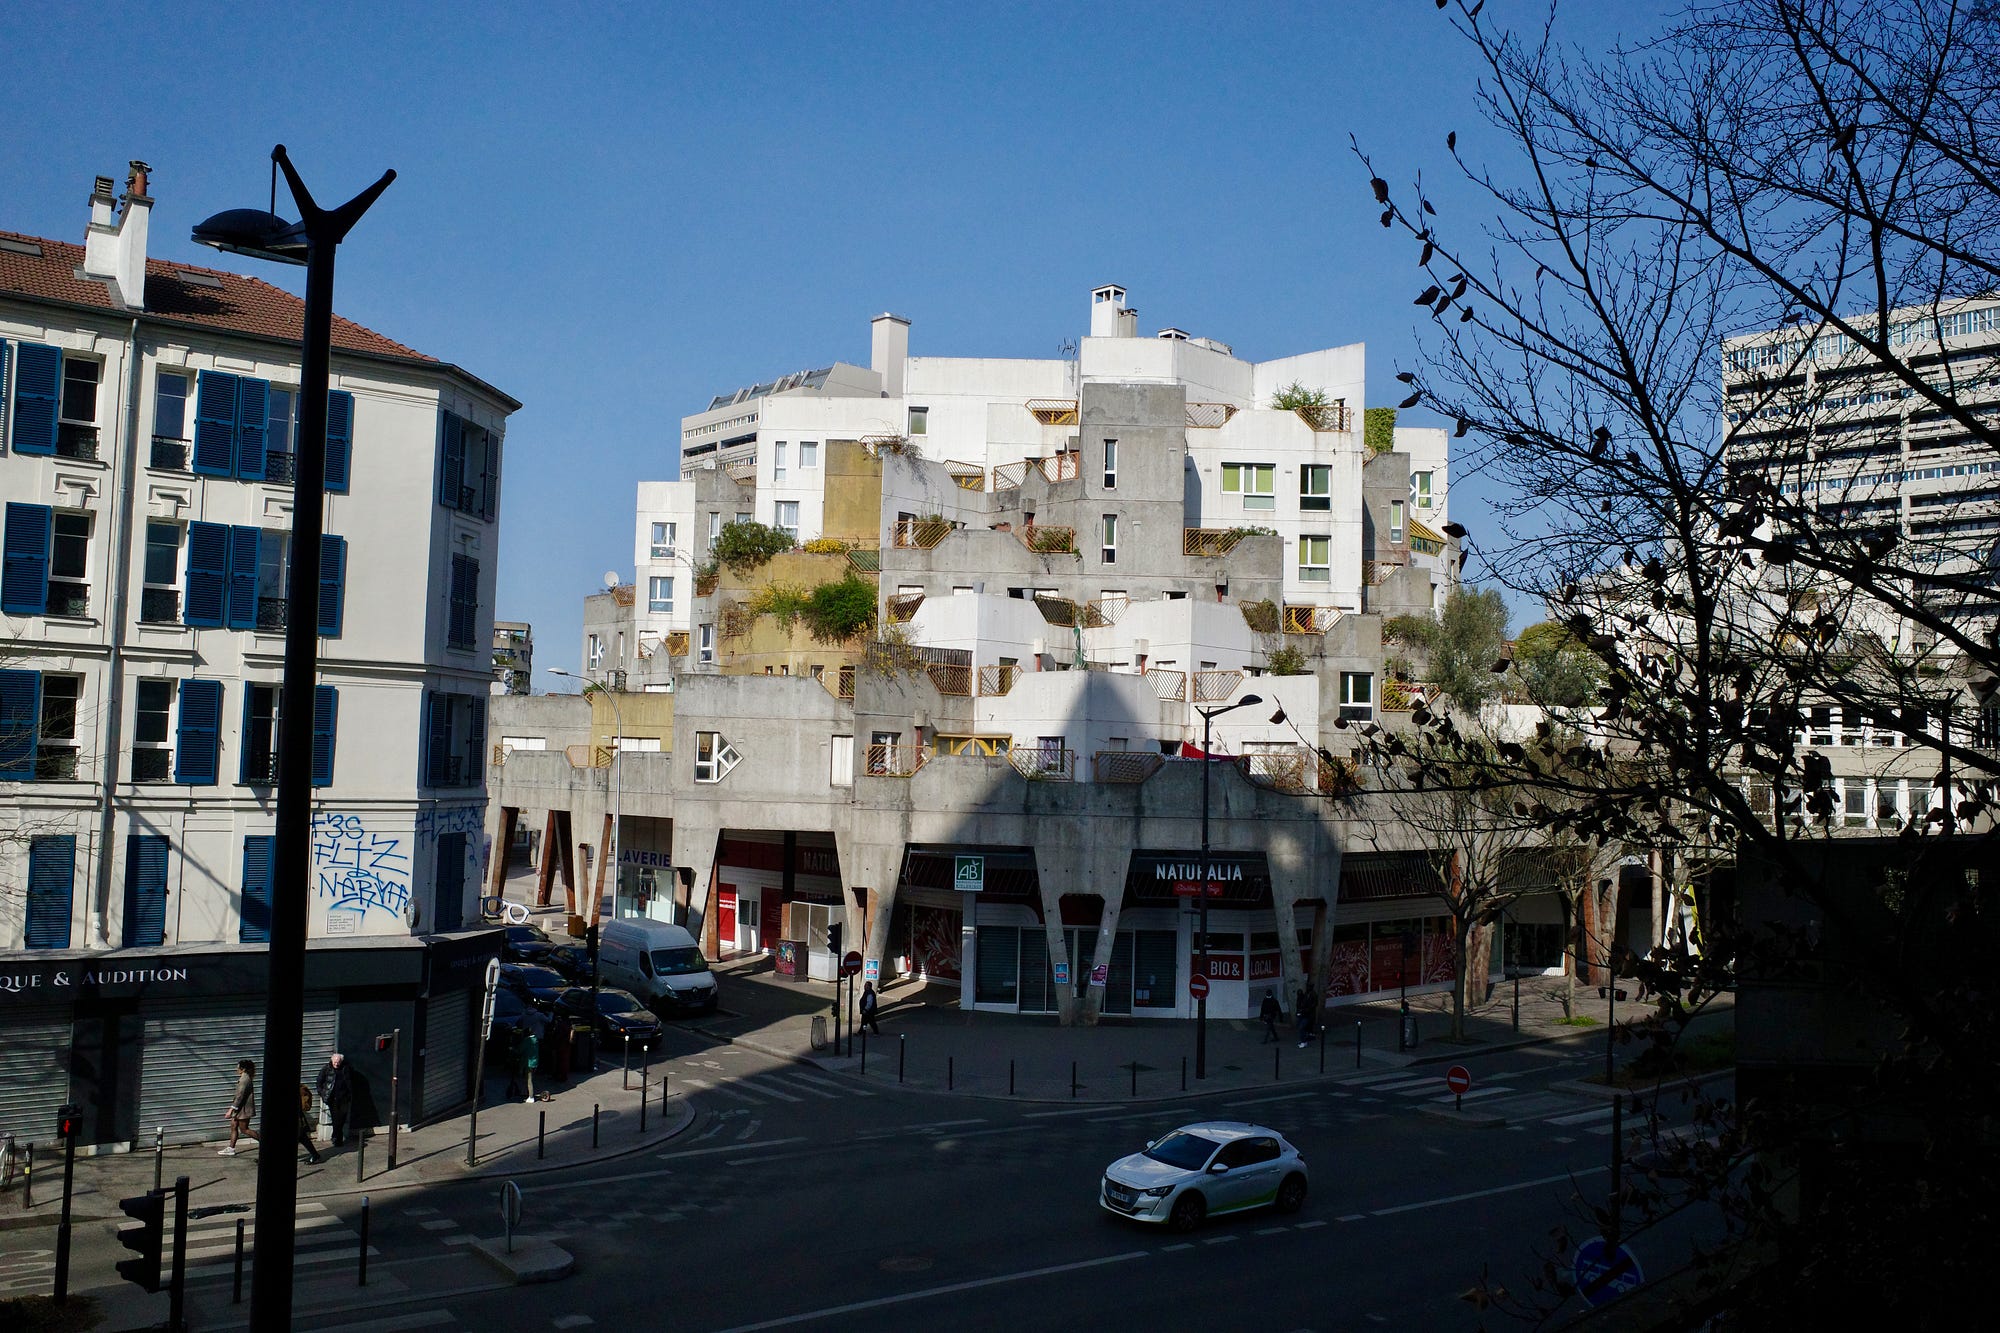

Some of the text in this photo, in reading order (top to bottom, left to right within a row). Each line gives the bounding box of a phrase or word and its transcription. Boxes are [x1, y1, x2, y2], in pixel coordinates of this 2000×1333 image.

[618, 849, 671, 868] AVERIE
[957, 864, 978, 880] AB
[53, 971, 71, 986] &
[82, 968, 187, 985] AUDITION
[1210, 959, 1273, 977] BIO & LOCAL
